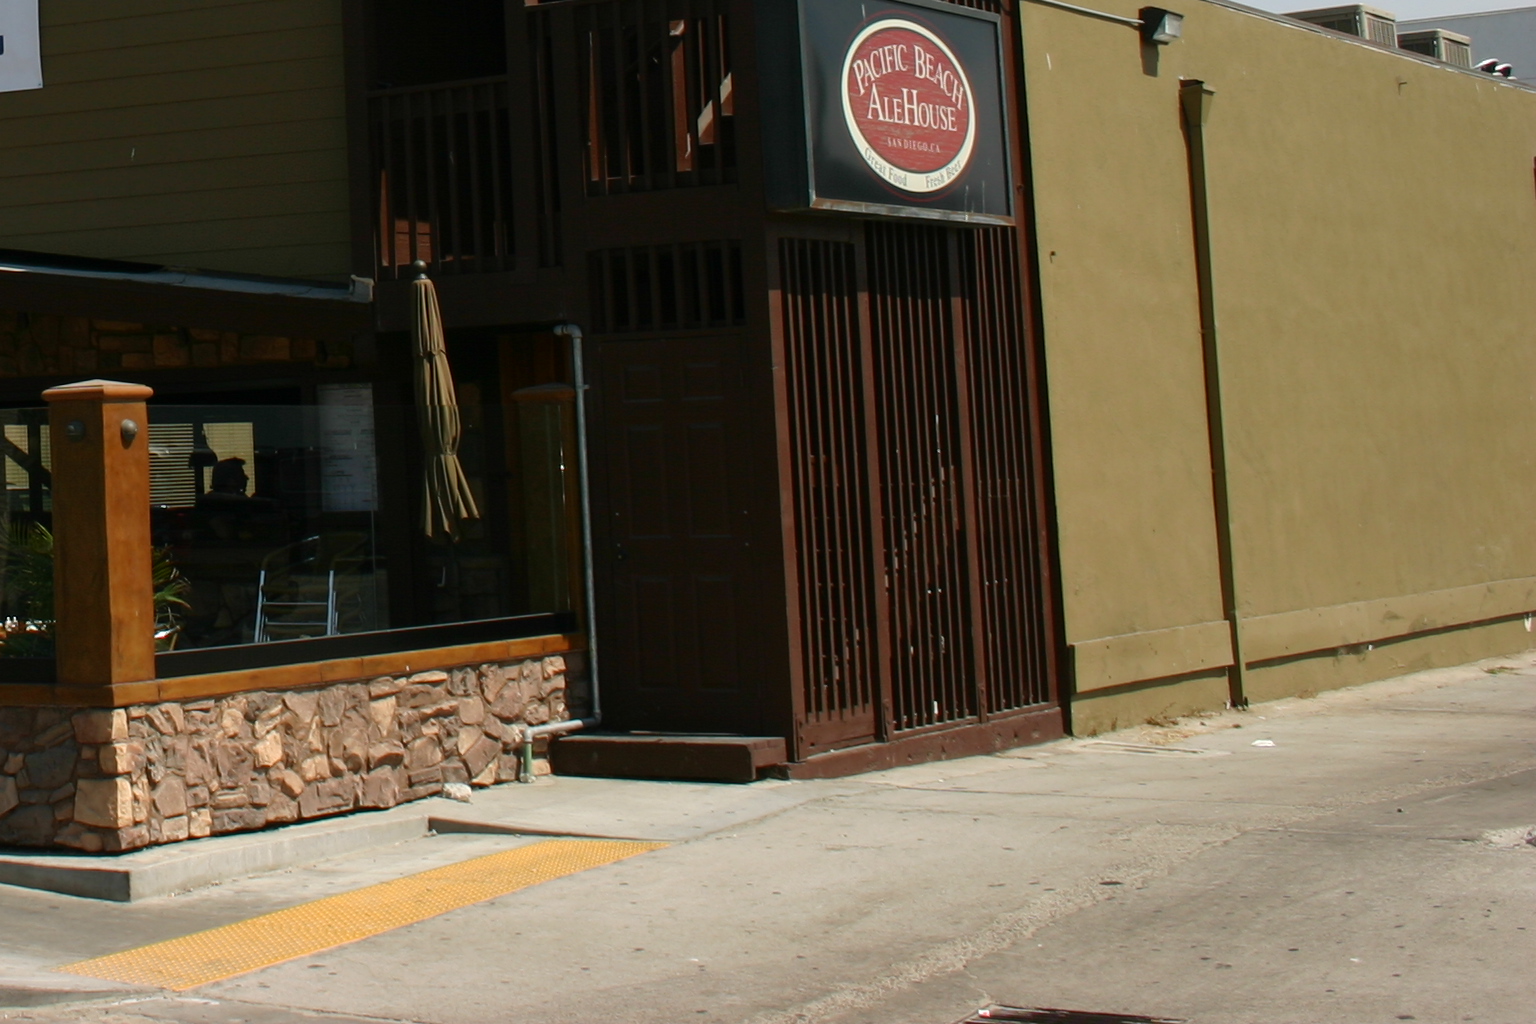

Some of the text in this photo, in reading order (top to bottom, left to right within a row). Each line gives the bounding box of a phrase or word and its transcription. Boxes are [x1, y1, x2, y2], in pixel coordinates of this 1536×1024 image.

[852, 44, 964, 110] PACIFIC BEACH
[888, 167, 907, 186] Food
[925, 172, 945, 188] Fresh
